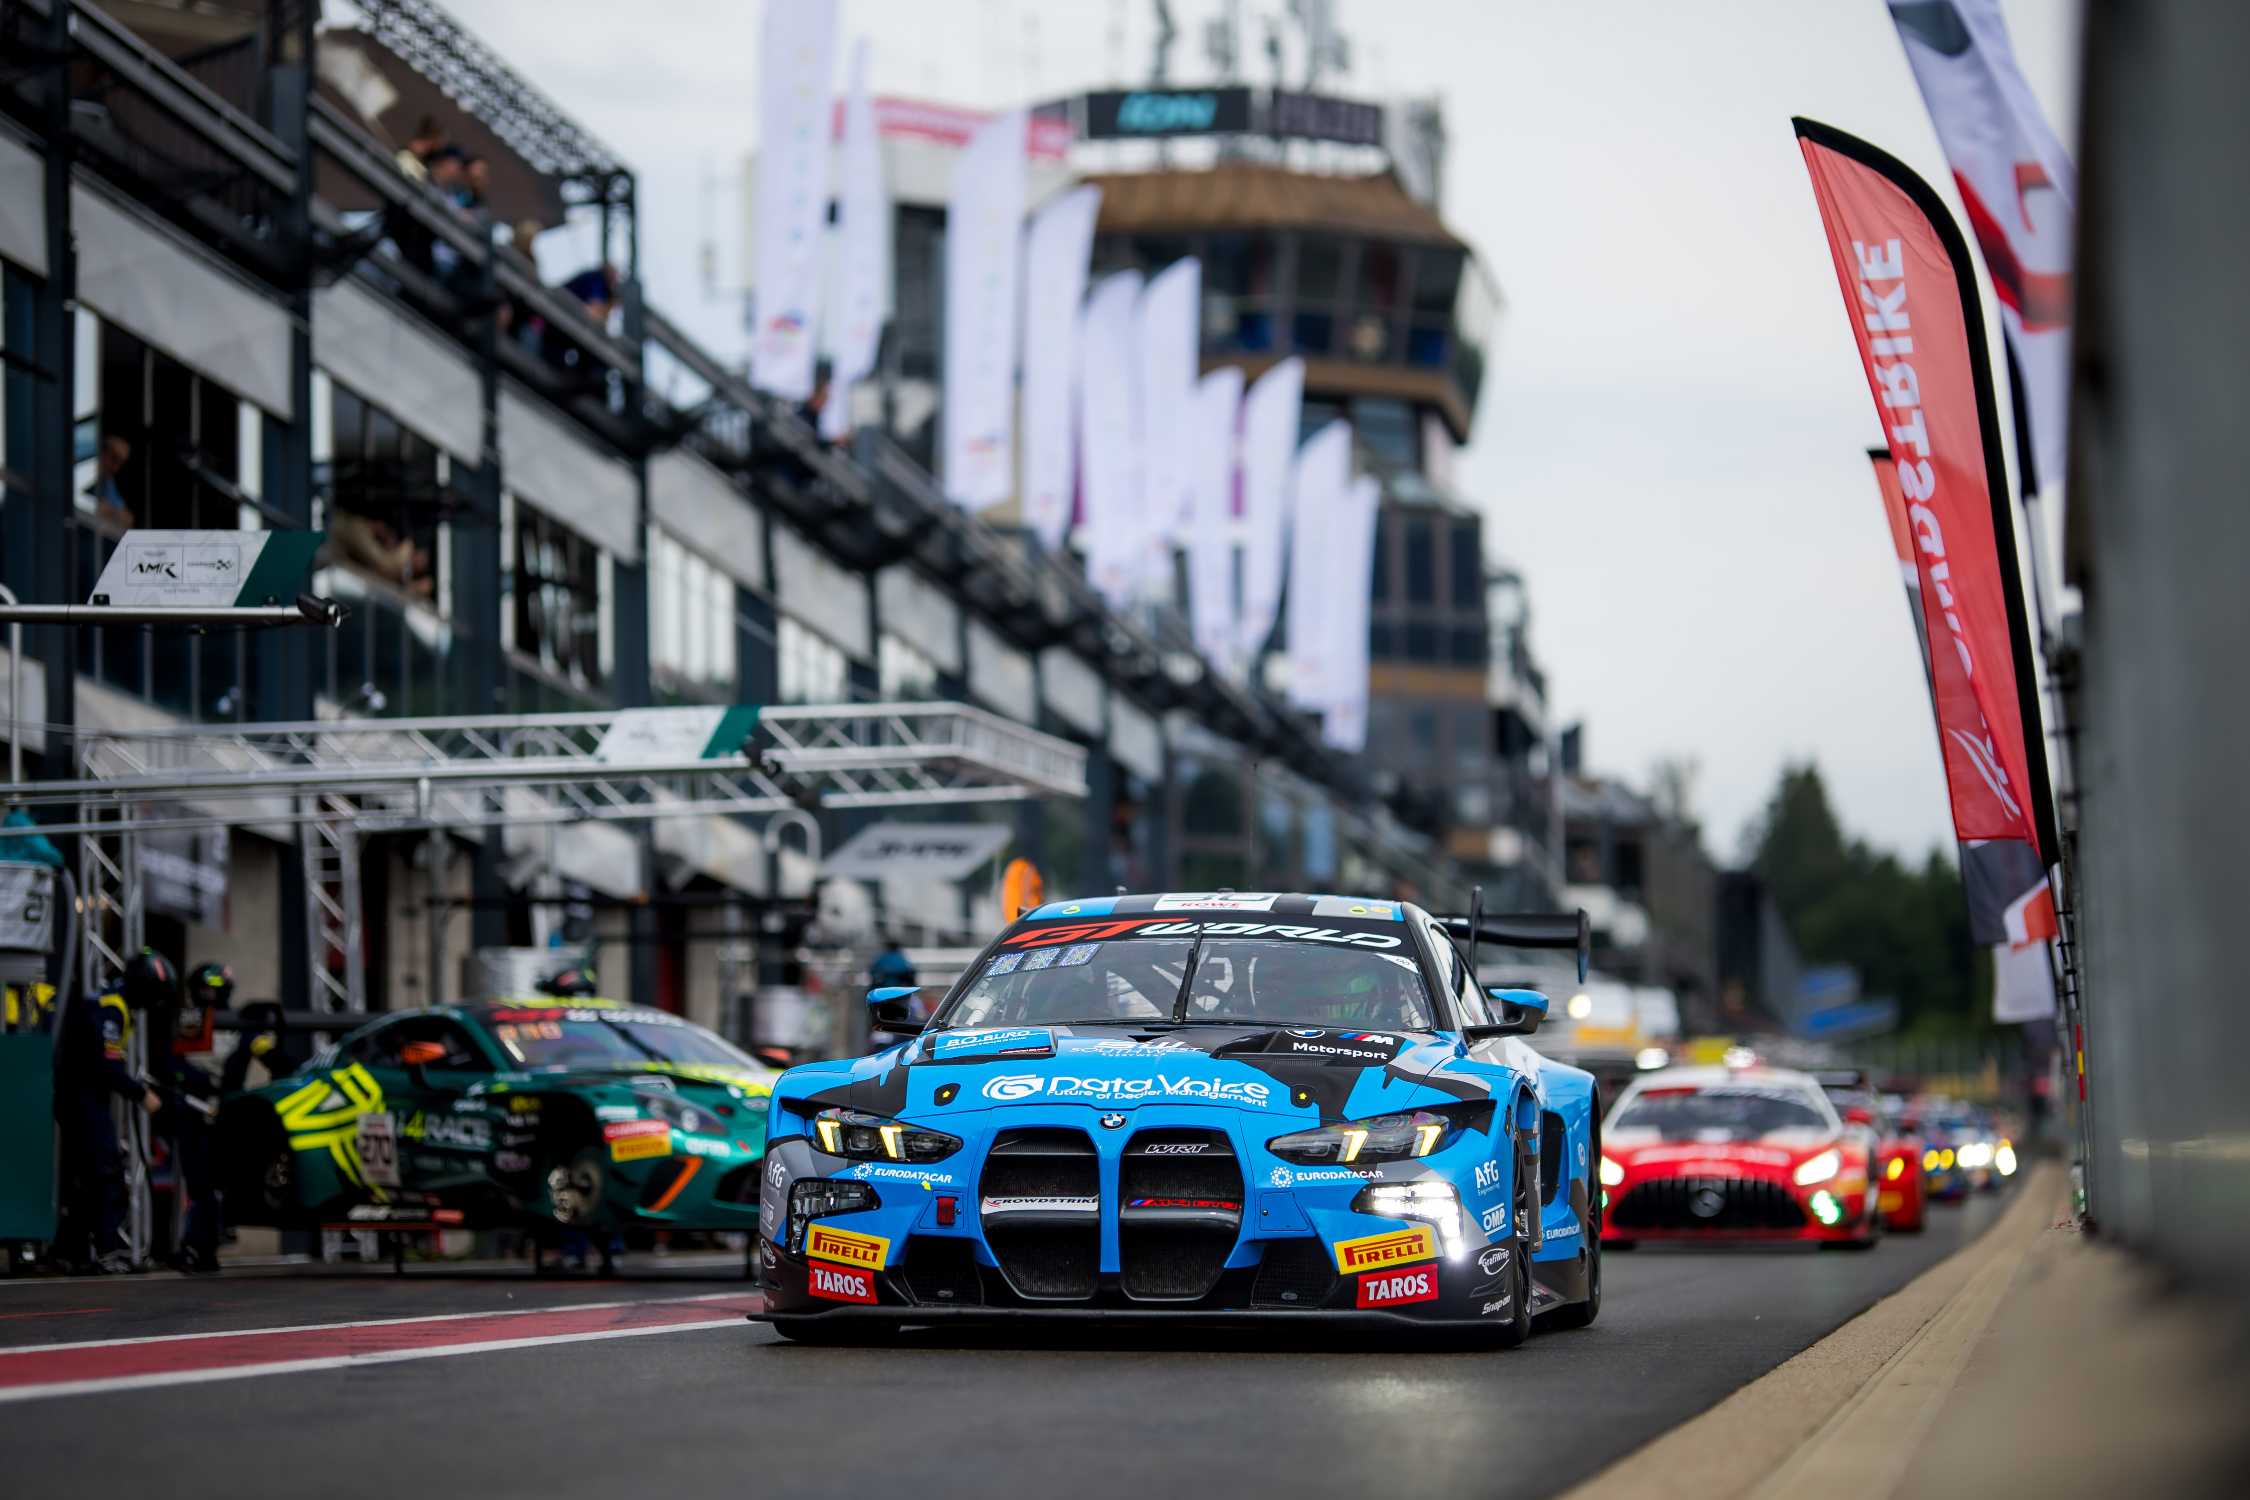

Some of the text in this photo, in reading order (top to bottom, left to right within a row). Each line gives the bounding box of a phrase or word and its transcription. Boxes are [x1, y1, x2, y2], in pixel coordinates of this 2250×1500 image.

[1136, 921, 1402, 948] WORLD
[1292, 1042, 1389, 1060] Motorsport
[1050, 1074, 1270, 1099] Data Voice
[1096, 1092, 1111, 1100] of
[1114, 1089, 1162, 1099] Dealer
[1165, 1088, 1268, 1108] Management
[1145, 1143, 1209, 1154] WRT
[766, 1160, 787, 1188] AfG
[874, 1167, 953, 1184] EURODATACAR
[1296, 1168, 1384, 1182] EURODATACAR
[1474, 1159, 1499, 1189] AfG
[1483, 1207, 1506, 1231] OMP
[813, 1231, 880, 1263] PIRELLI
[1344, 1233, 1425, 1266] PIRELLI
